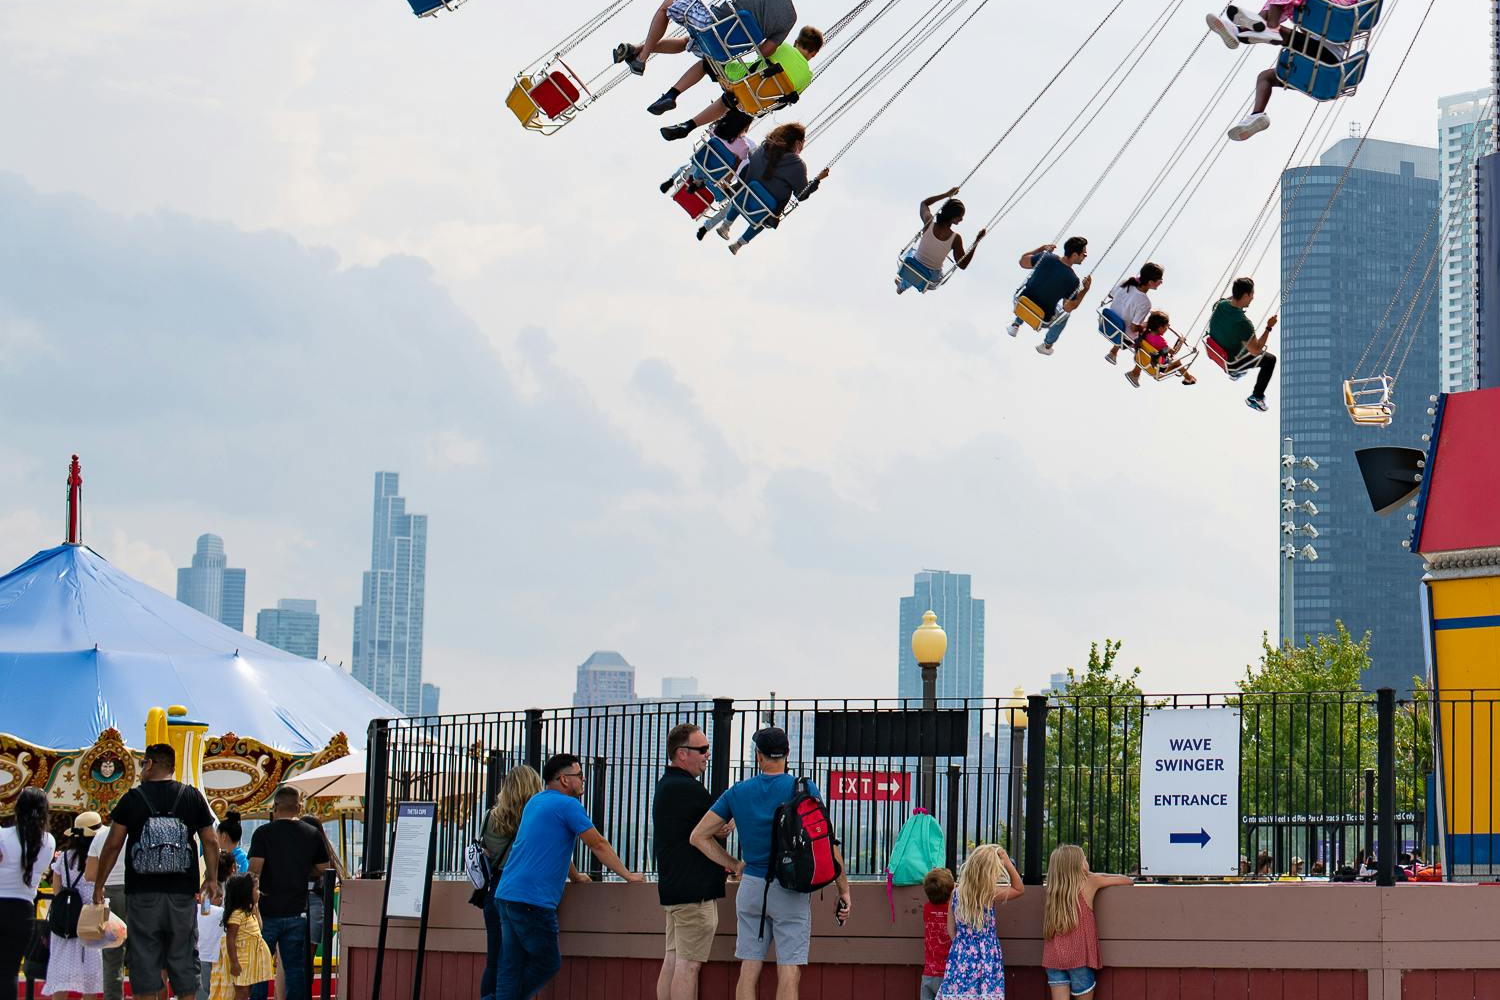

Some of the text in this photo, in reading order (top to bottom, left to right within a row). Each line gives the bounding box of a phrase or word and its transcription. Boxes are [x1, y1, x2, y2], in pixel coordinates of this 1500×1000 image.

[1169, 738, 1212, 751] WAVE
[1155, 758, 1225, 772] SWINGER
[839, 778, 871, 794] EXT
[1154, 794, 1228, 806] ENTRANCE
